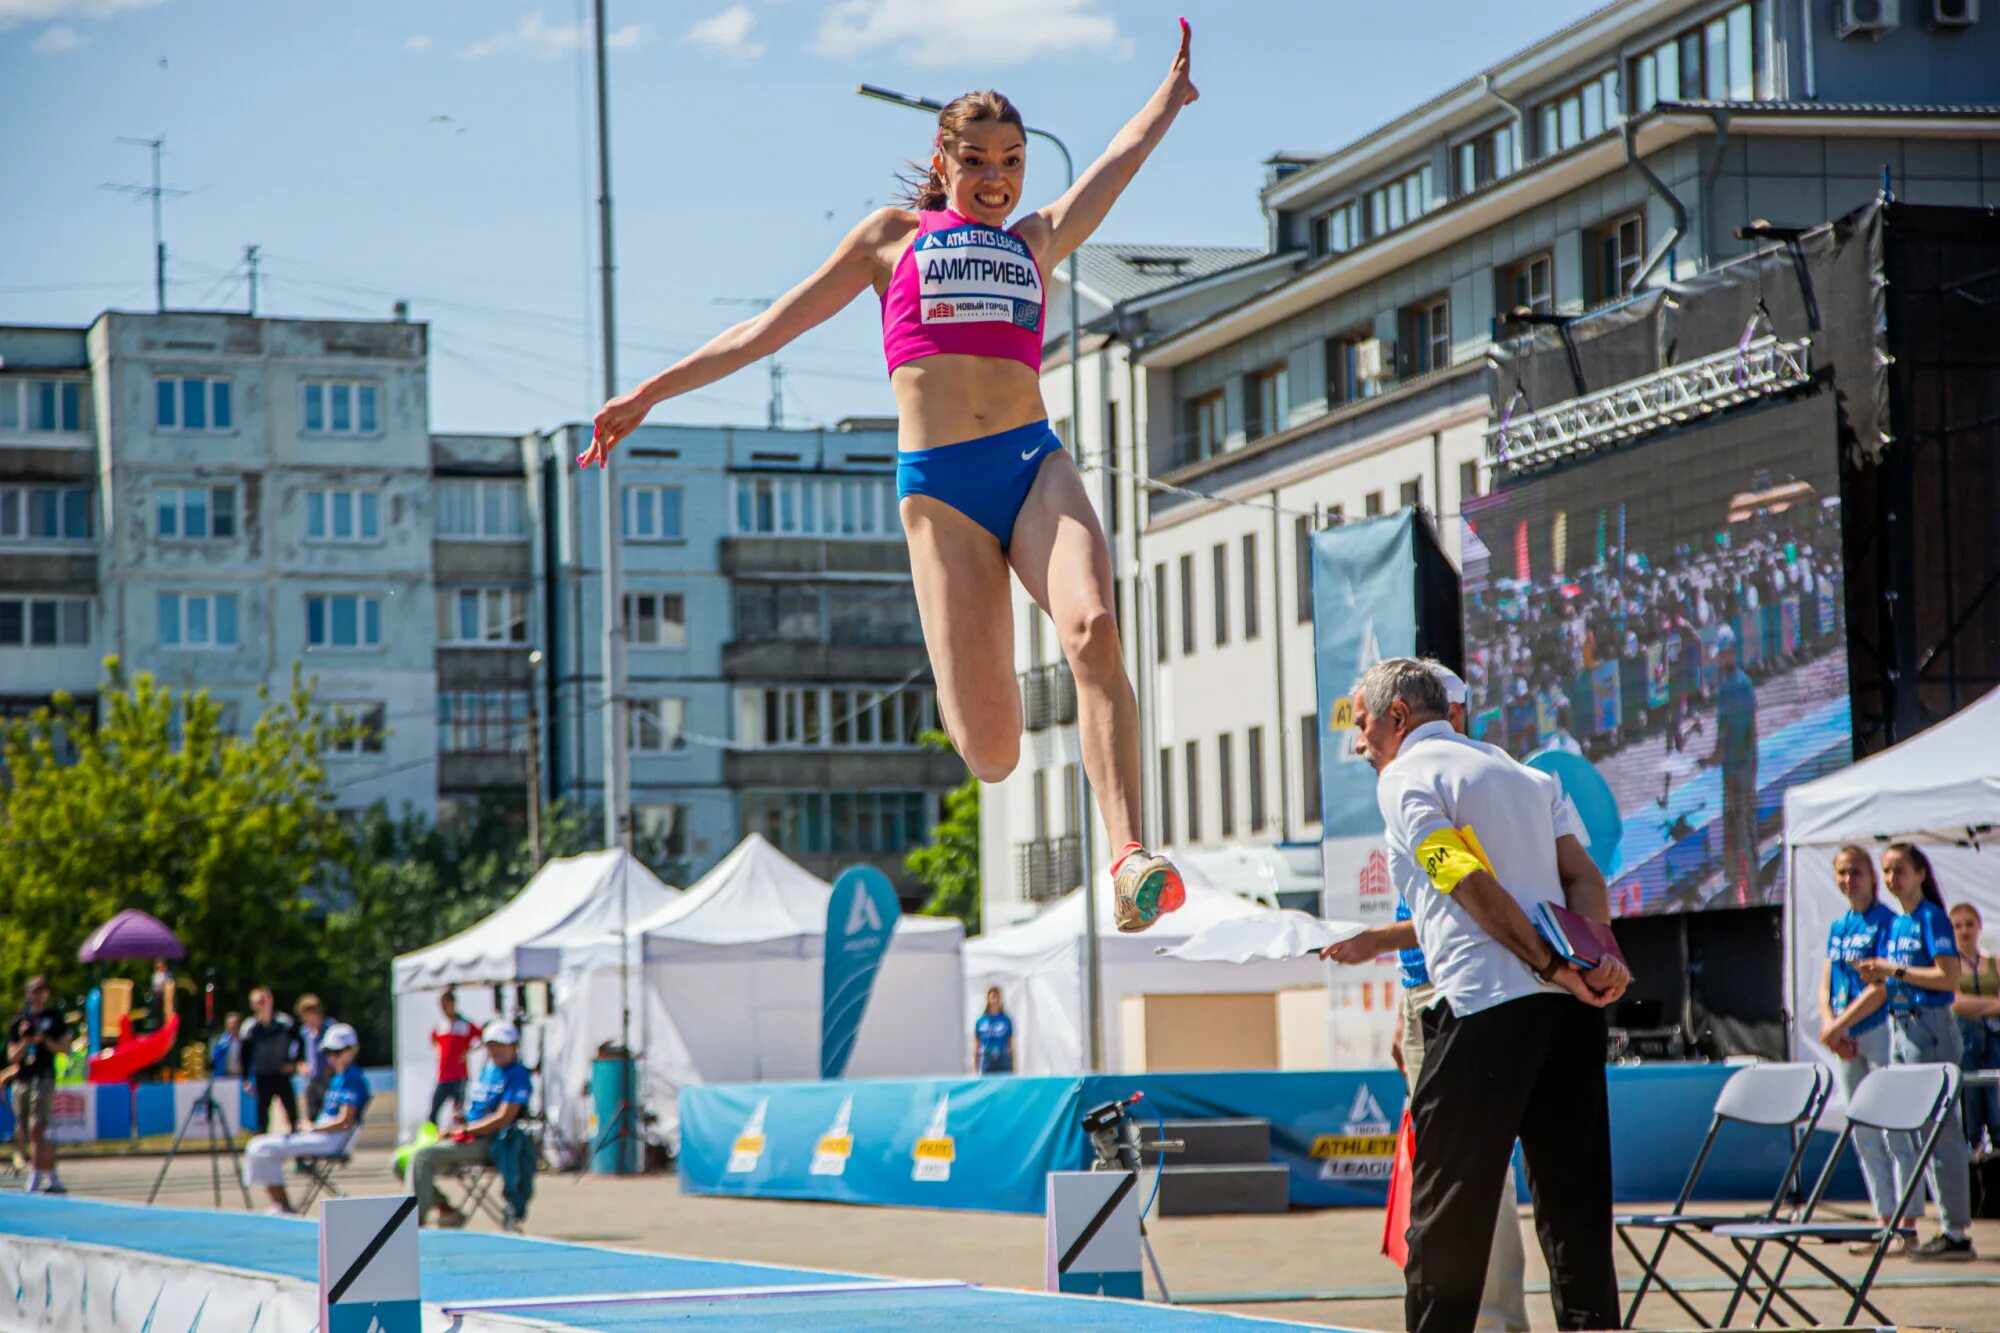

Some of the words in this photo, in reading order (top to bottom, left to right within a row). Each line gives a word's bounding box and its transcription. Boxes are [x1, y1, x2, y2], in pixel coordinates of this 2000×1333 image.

[946, 229, 995, 247] ATHLETICS
[996, 233, 1026, 256] LEAGUE
[925, 257, 1038, 289] ДМИТРИЕВА
[956, 300, 984, 311] НОВЫЙ
[985, 302, 1010, 313] ГОРОД
[1318, 1139, 1397, 1155] ATHLETI
[1331, 1161, 1394, 1176] LEAGU
